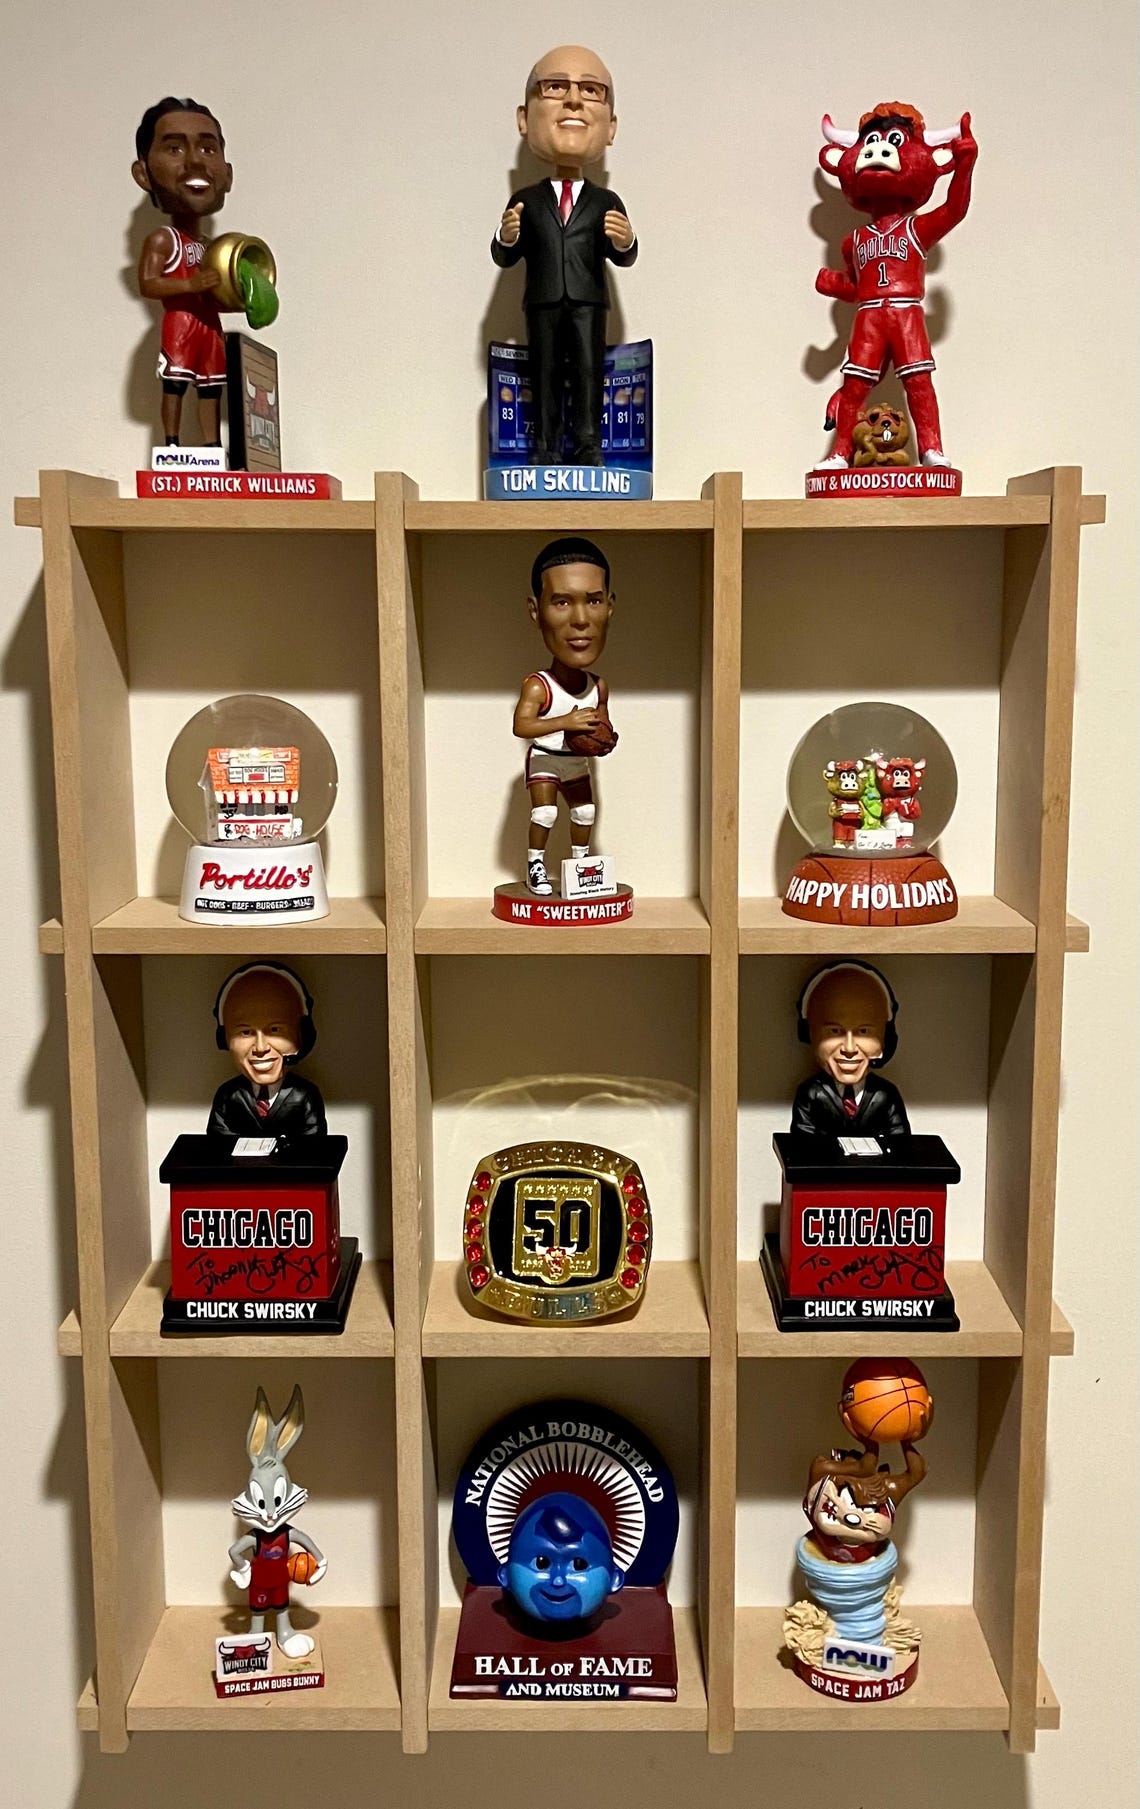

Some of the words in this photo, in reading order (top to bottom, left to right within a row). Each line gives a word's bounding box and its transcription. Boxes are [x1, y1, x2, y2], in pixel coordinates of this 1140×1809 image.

[857, 235, 908, 270] BULLS
[878, 262, 889, 287] 1
[502, 407, 514, 420] 83
[617, 411, 628, 424] 81
[156, 454, 191, 466] now
[191, 456, 220, 467] Arena
[151, 477, 181, 493] (ST.)
[187, 477, 243, 492] PATRICK
[247, 478, 317, 494] WILLIAMS
[501, 469, 537, 491] TOM
[543, 469, 631, 494] SKILLING
[829, 475, 838, 490] &
[840, 473, 923, 490] WOODSTOCK
[256, 824, 285, 836] HOUSE
[199, 862, 312, 890] Portillo's
[786, 875, 848, 907] HAPPY
[851, 877, 954, 910] HOLIDAYS
[256, 900, 289, 910] BURGERS
[511, 902, 532, 919] NAT
[182, 1209, 313, 1248] CHICAGO
[522, 1198, 592, 1254] 50
[802, 1207, 933, 1246] CHICAGO
[187, 1302, 239, 1318] CHUCK
[244, 1303, 317, 1319] SWIRSKY
[804, 1301, 856, 1317] CHUCK
[861, 1300, 935, 1316] SWIRSKY
[465, 1425, 545, 1507] NATIONAL
[547, 1421, 664, 1503] BOBBLEHEAD
[224, 1660, 248, 1672] WINDY
[250, 1656, 267, 1668] CITY
[474, 1656, 546, 1676] HALL
[550, 1663, 574, 1676] OF
[578, 1657, 653, 1677] FAME
[224, 1682, 251, 1694] SPACE
[252, 1680, 270, 1691] JAM
[271, 1679, 291, 1689] BUGS
[293, 1676, 320, 1686] BUNNY
[505, 1683, 541, 1696] AND
[545, 1684, 620, 1697] MUSEUM
[811, 1674, 850, 1697] SPACE
[854, 1685, 882, 1699] JAM
[886, 1678, 905, 1696] TAZ
